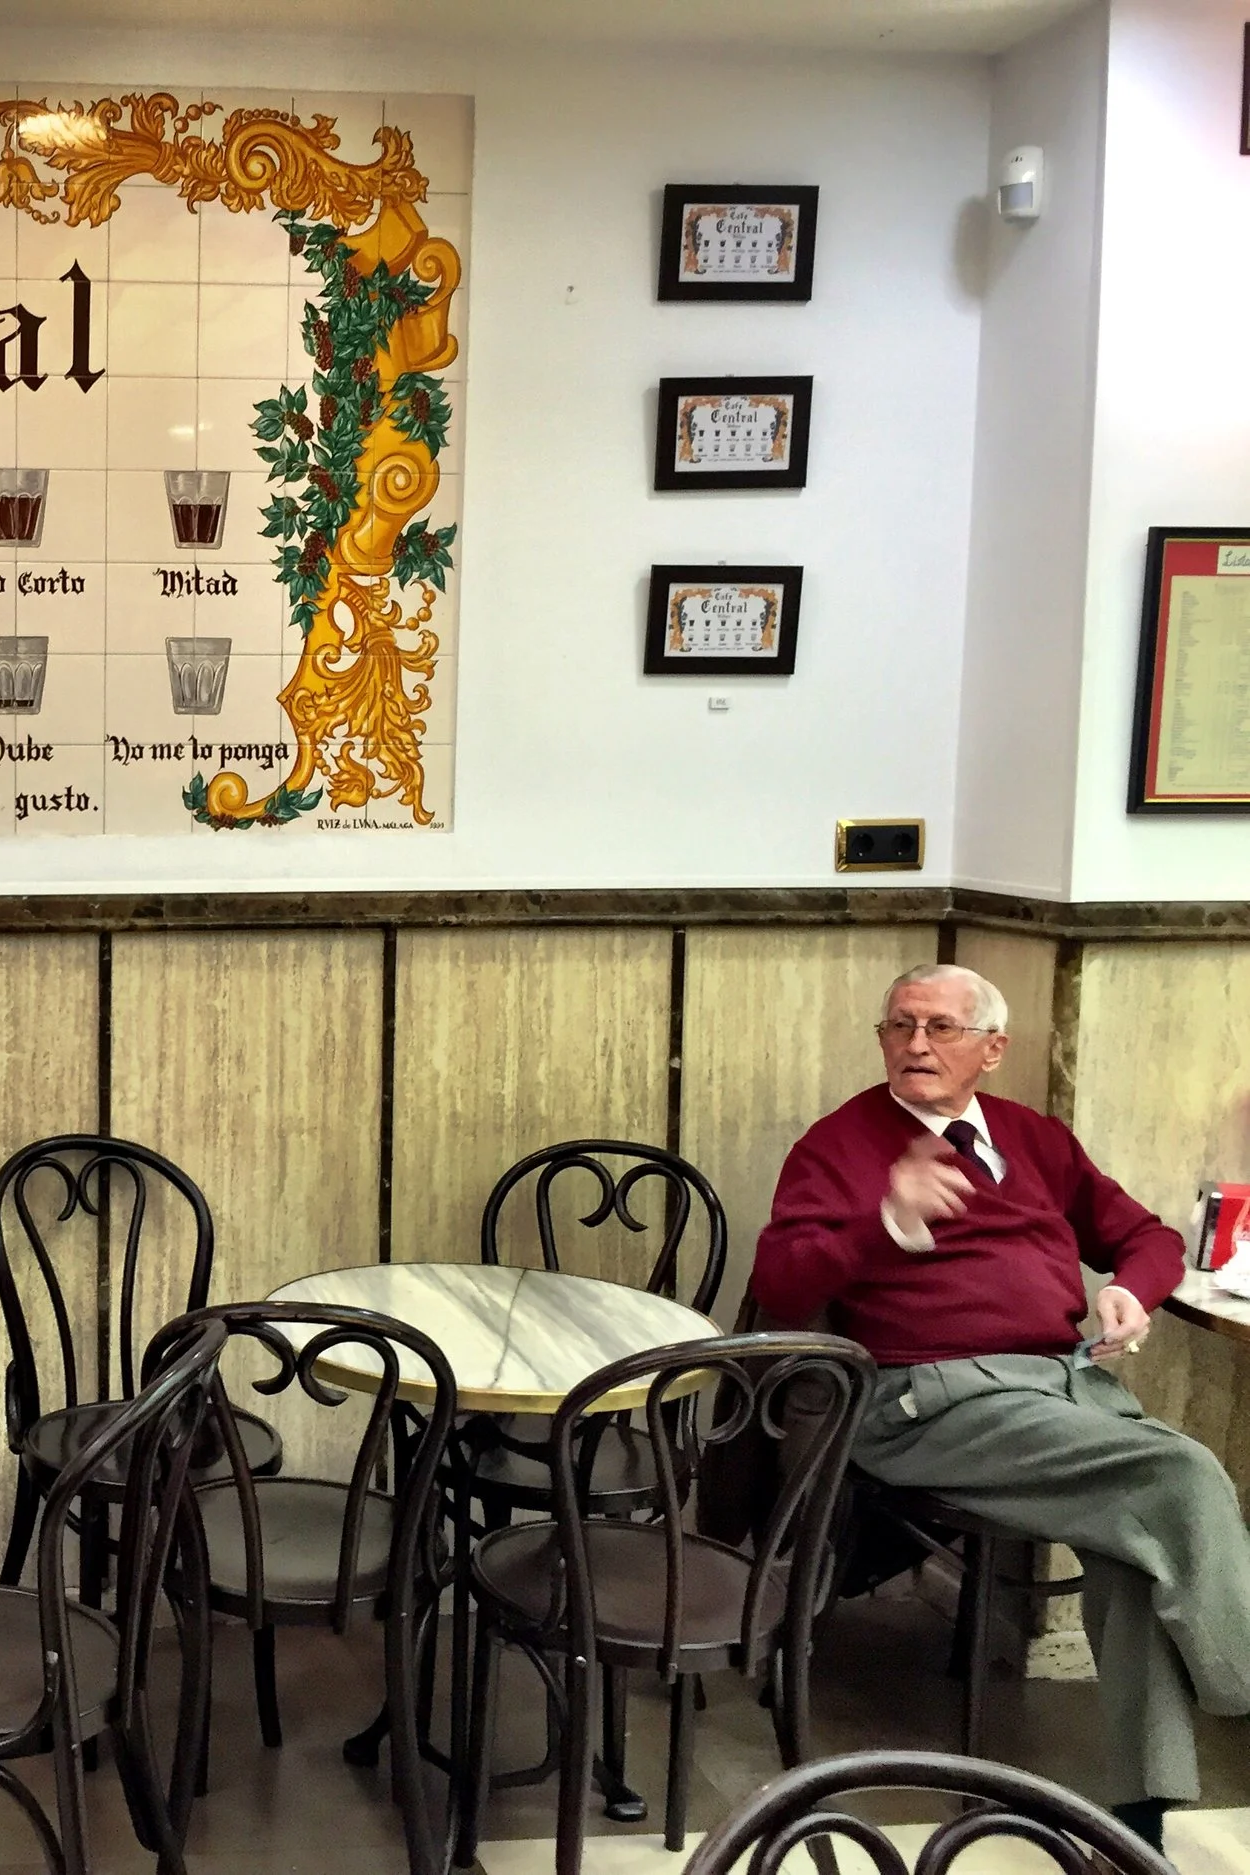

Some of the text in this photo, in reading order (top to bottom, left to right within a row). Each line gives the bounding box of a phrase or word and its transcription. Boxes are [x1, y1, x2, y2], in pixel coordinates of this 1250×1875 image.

[716, 219, 763, 233] Central
[710, 409, 758, 424] Central
[17, 567, 86, 596] Corto
[152, 564, 238, 599] Mitad
[701, 600, 748, 614] Central
[105, 734, 290, 770] No me lo ponga
[15, 786, 100, 821] gusto.
